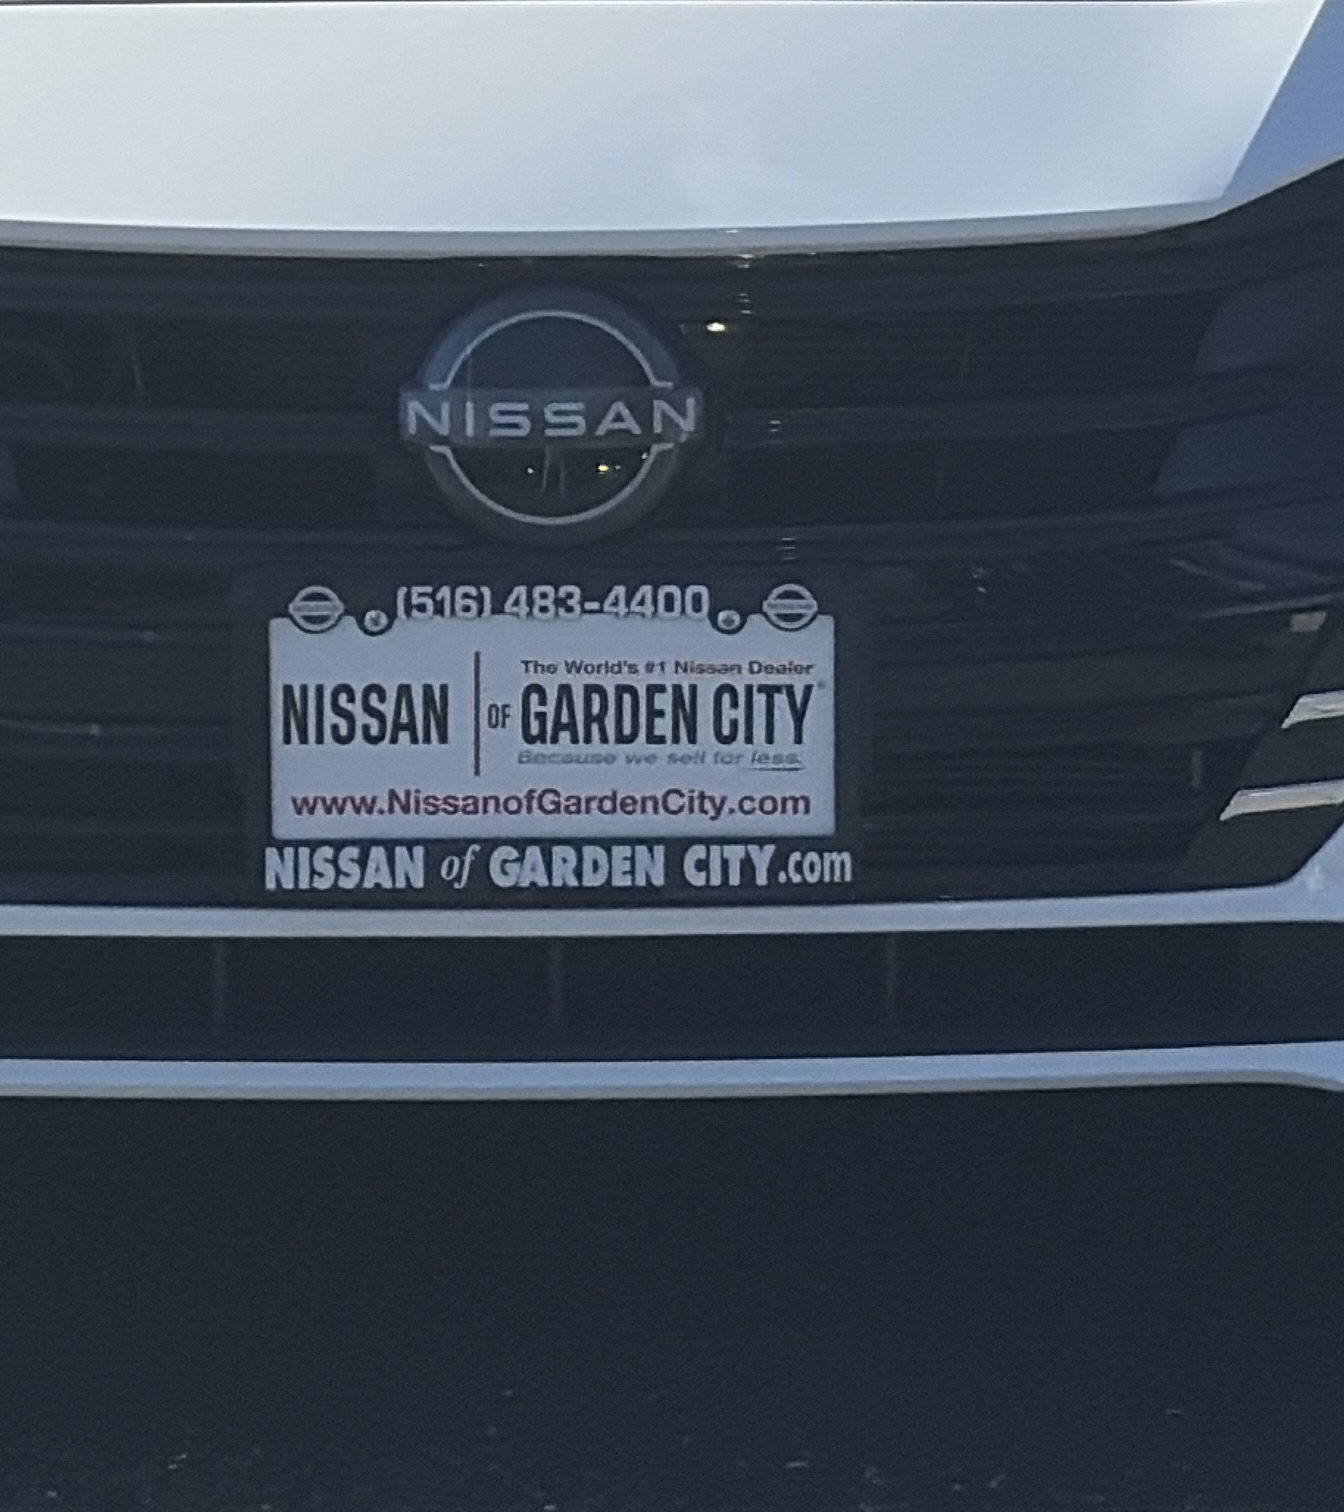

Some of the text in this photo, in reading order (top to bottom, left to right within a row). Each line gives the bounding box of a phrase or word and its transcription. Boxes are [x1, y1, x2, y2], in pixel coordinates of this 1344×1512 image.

[407, 397, 696, 437] NISSAN
[396, 583, 710, 620] (516) 483-4400
[521, 659, 816, 675] The World's #1 Nissan Dealer
[282, 682, 814, 746] NISSAN OF GARDEN CITY
[517, 750, 617, 765] Because
[624, 753, 659, 765] we
[667, 750, 707, 765] sell
[713, 750, 742, 765] for
[290, 788, 811, 821] www.NissanofGardenCity.com
[264, 844, 853, 890] NISSAN of GARDEN CITY.com
